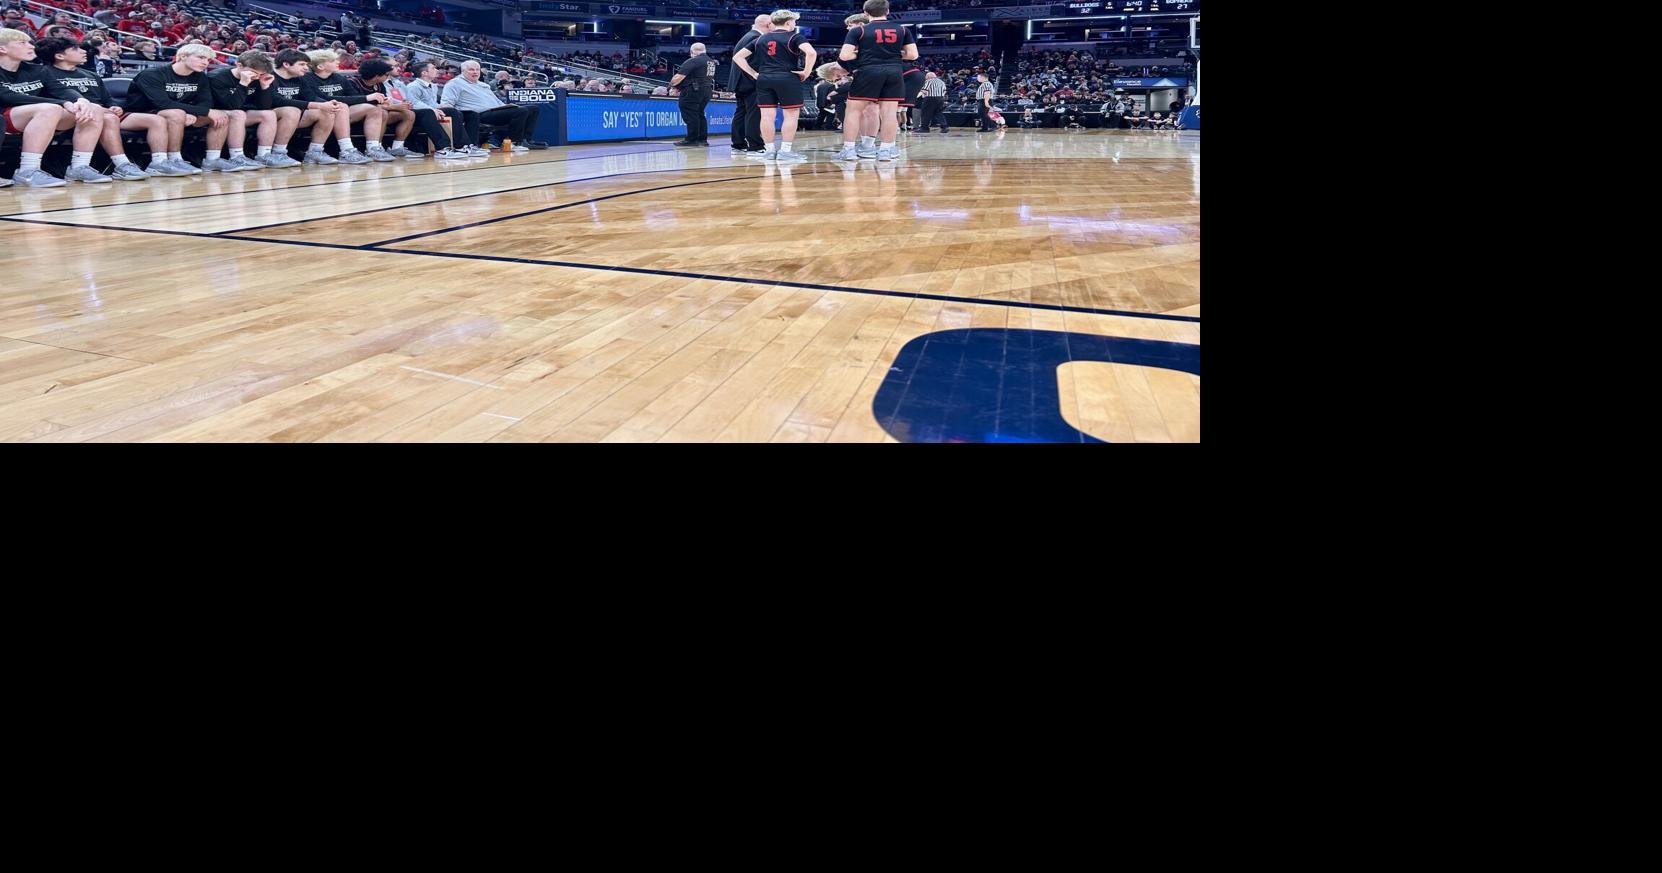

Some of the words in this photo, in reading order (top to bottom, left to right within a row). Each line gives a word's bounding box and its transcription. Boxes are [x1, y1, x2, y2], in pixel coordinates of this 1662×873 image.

[875, 28, 897, 43] 15
[767, 41, 777, 56] 3
[603, 111, 618, 128] SAY
[646, 111, 656, 127] TO
[656, 111, 677, 127] ORGAN
